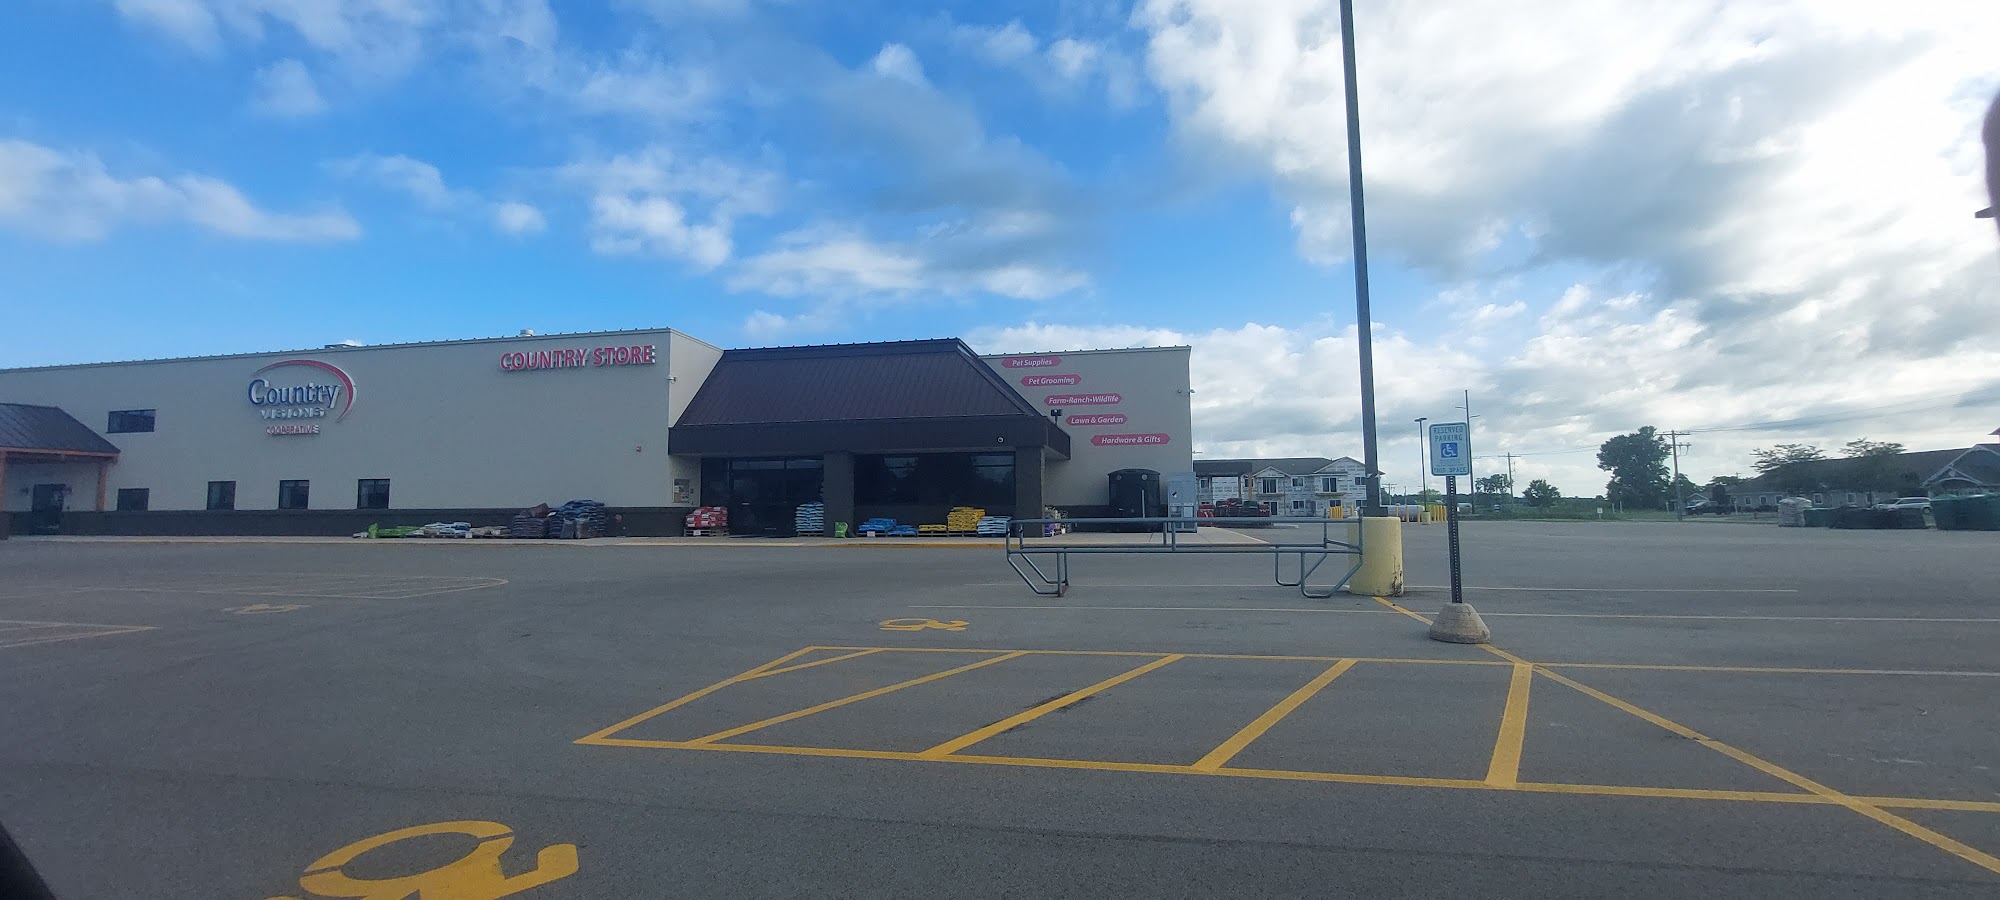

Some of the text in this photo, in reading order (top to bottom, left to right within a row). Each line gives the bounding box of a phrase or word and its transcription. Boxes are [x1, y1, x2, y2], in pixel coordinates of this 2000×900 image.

[500, 345, 655, 370] COUNTRY STORE
[1012, 358, 1052, 367] Pet Supplies
[1040, 377, 1075, 385] Grooming
[248, 379, 340, 409] Country
[261, 407, 326, 420] VISIONS
[1090, 416, 1097, 424] &
[266, 424, 320, 435] COOPERATIVE
[1433, 426, 1464, 434] RESERVED
[1101, 436, 1136, 444] Hardware
[1144, 435, 1161, 443] Gifts
[1435, 434, 1463, 442] PARKING
